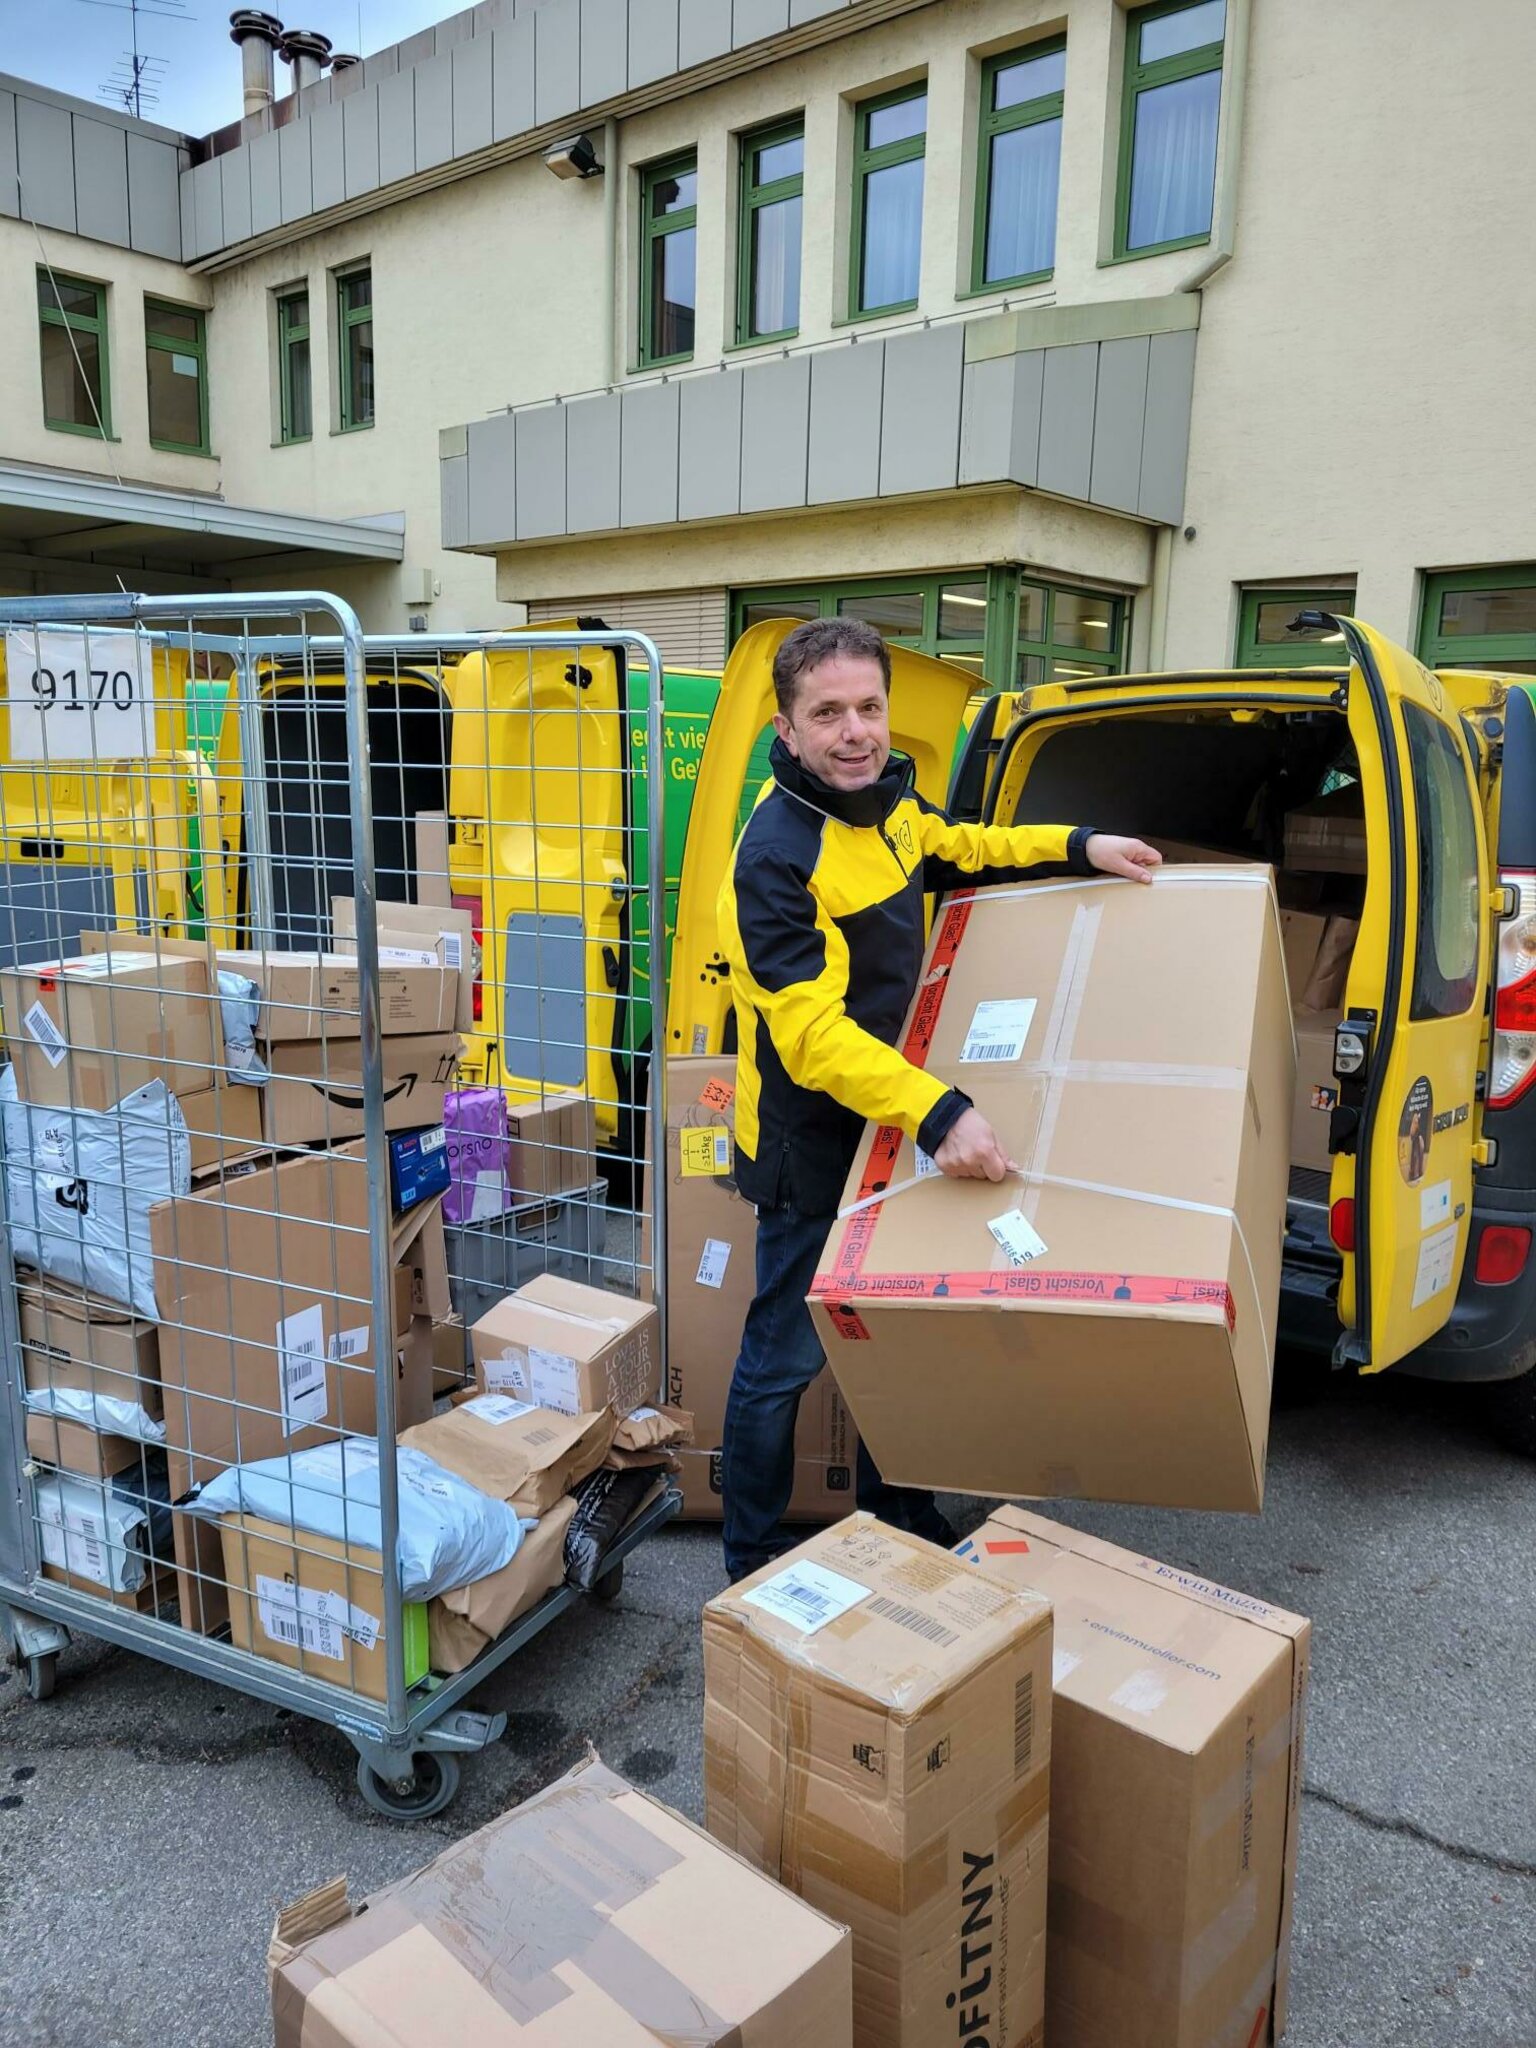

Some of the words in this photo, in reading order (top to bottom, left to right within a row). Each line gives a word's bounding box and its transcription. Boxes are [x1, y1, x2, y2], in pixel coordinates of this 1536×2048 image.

[31, 668, 133, 711] 9170
[915, 1015, 932, 1035] Glas!
[881, 1126, 894, 1144] las!
[842, 1243, 861, 1267] Glas!
[1013, 1251, 1033, 1267] A19
[699, 1270, 713, 1281] A19
[835, 1277, 868, 1291] Glas!
[1005, 1276, 1042, 1291] Glas!
[871, 1279, 925, 1291] Vorsicht
[1046, 1280, 1105, 1295] Vorsicht
[605, 1340, 636, 1376] LOVE
[639, 1328, 649, 1348] IS
[608, 1375, 617, 1391] A
[619, 1346, 649, 1380] FOUR
[1155, 1566, 1209, 1593] Erwin
[1211, 1587, 1272, 1615] Müller
